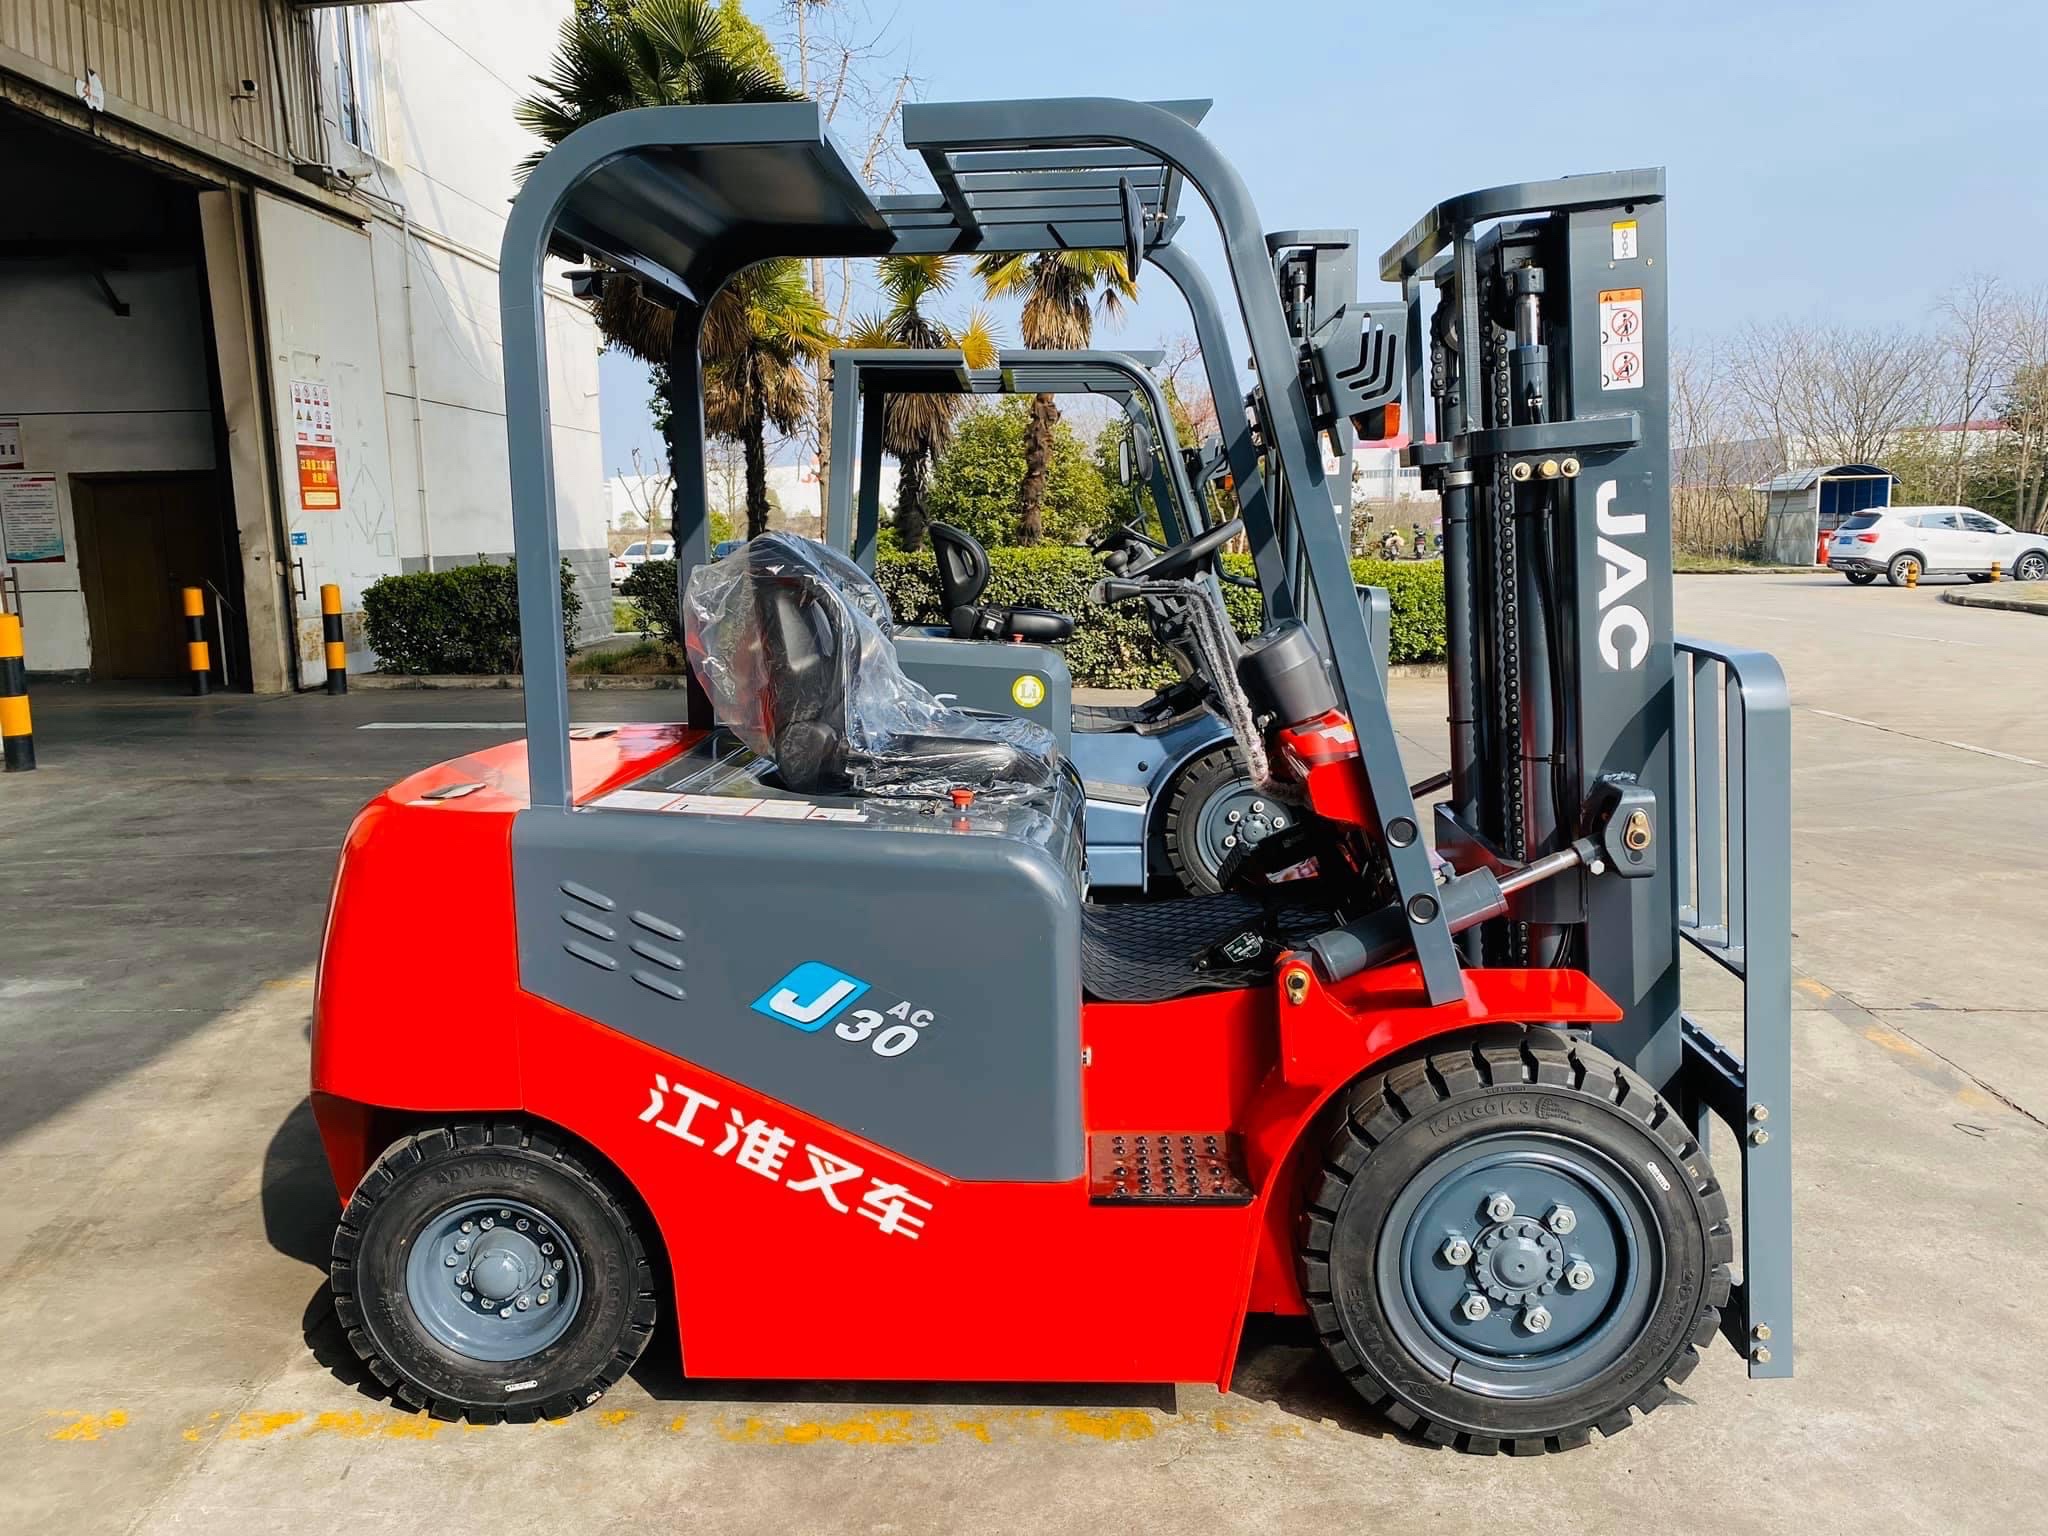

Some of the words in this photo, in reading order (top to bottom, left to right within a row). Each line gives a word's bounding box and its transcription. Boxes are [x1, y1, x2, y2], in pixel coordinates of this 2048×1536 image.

[1596, 479, 1650, 671] JAC
[769, 979, 857, 1022] J
[834, 1009, 919, 1057] 30
[886, 1000, 935, 1028] AC
[638, 1073, 934, 1240] 江淮叉车
